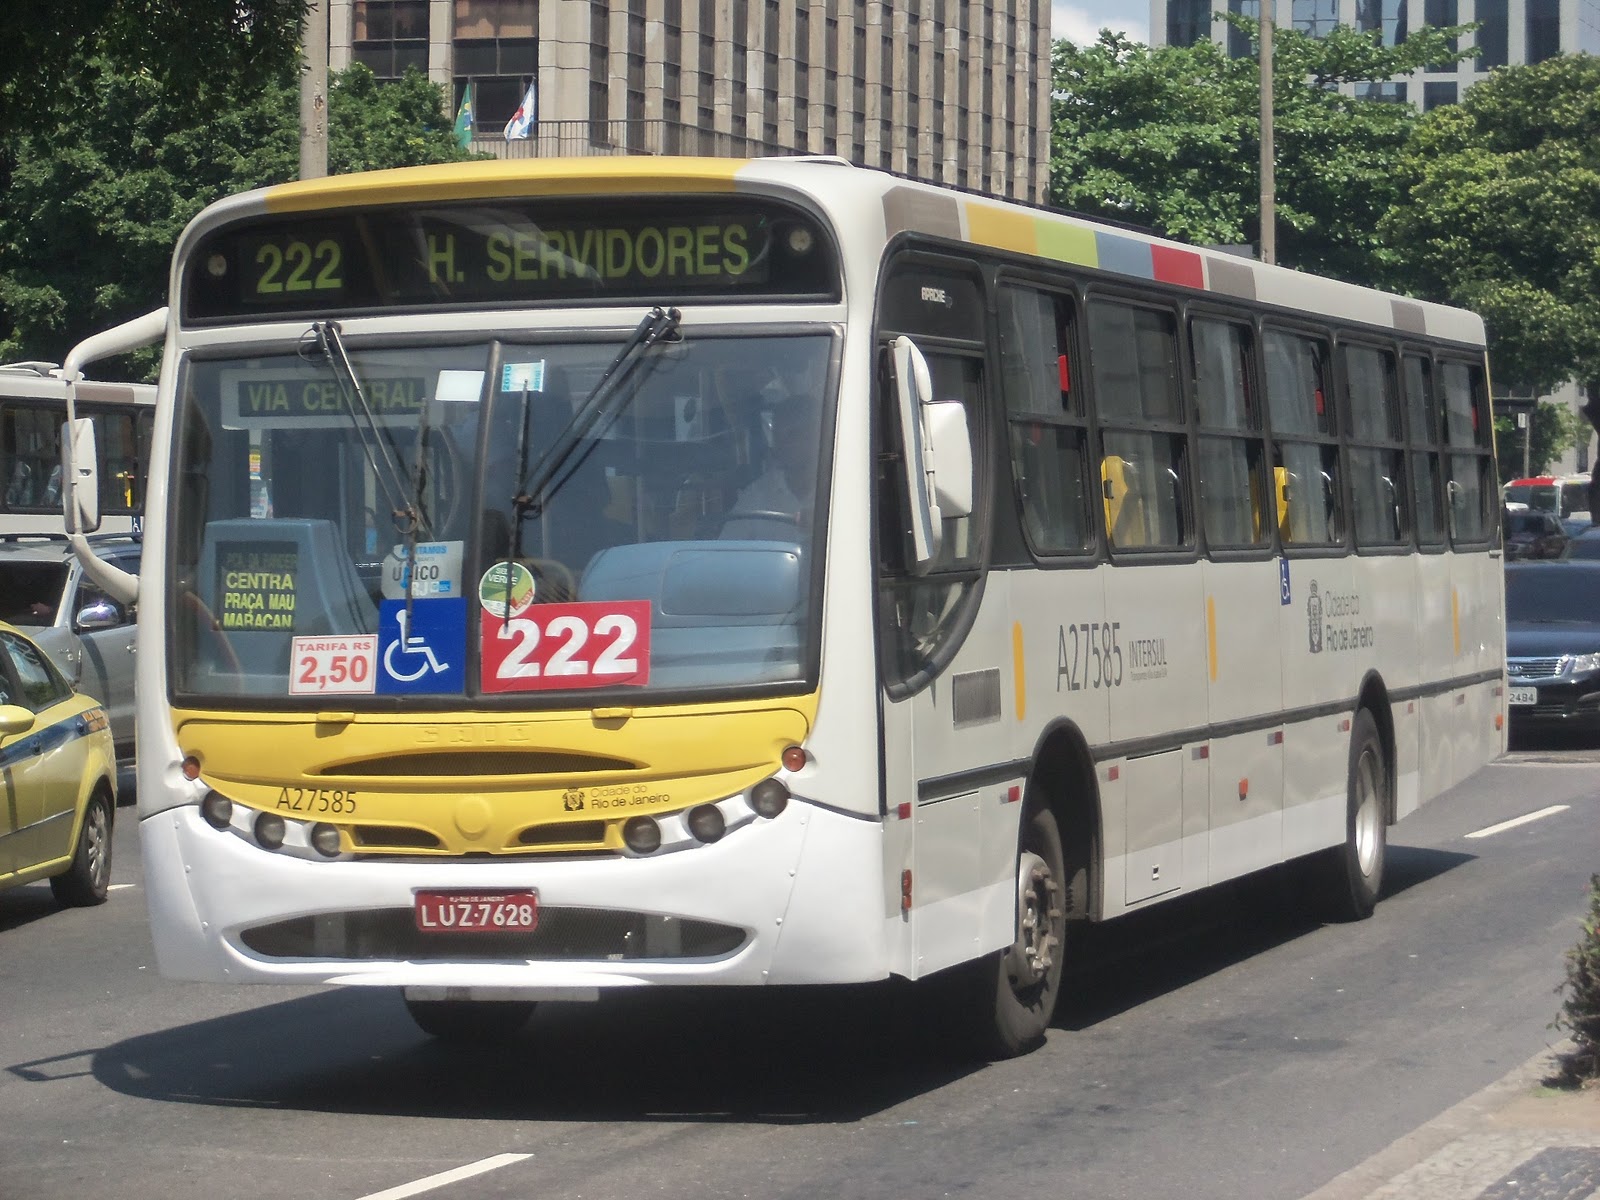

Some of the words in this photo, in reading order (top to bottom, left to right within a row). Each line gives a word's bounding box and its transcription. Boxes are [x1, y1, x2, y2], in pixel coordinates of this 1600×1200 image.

[256, 240, 343, 294] 222
[428, 234, 465, 283] H.
[486, 223, 749, 282] SERVIDORES
[248, 383, 290, 412] VIA
[225, 572, 294, 591] CENTRA
[392, 565, 440, 582] UICO
[487, 574, 519, 586] VERE
[224, 592, 265, 614] PRAÇA
[268, 593, 295, 611] MAU
[223, 612, 293, 628] MARACAN
[298, 642, 348, 652] TARIFA
[496, 614, 638, 679] 222
[1057, 622, 1123, 692] A27585
[1128, 638, 1168, 669] INTERSUL
[298, 655, 369, 690] 2,50
[276, 787, 357, 814] A27585
[591, 786, 630, 798] Cidade
[633, 784, 648, 794] do
[592, 799, 610, 810] Rio
[612, 797, 627, 808] de
[629, 793, 671, 807] Janeiro
